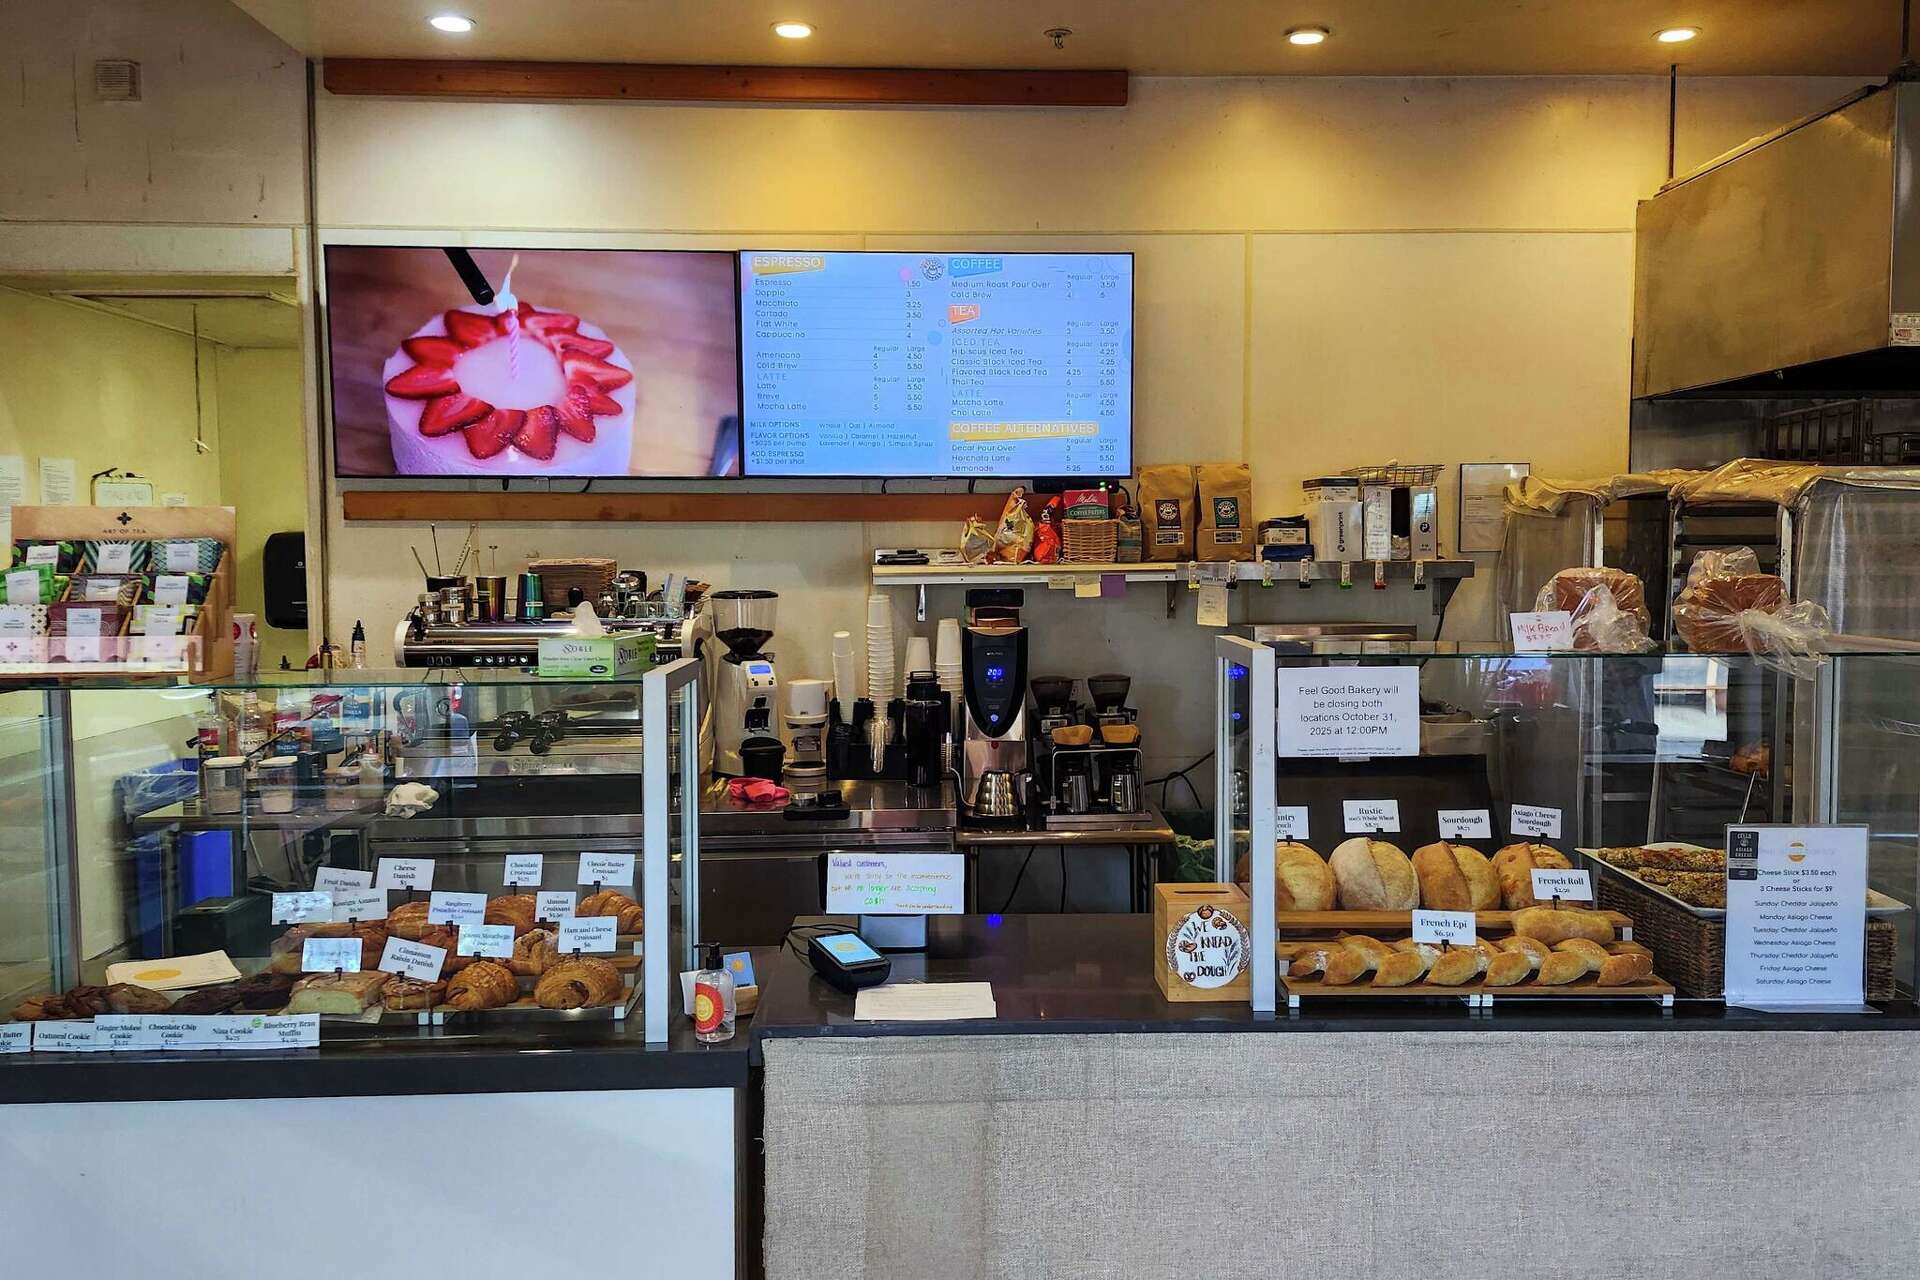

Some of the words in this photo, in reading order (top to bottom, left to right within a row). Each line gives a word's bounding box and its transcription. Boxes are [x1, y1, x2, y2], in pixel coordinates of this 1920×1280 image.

[754, 256, 821, 268] ESPRESSO
[952, 258, 1000, 269] COFFEE
[952, 306, 975, 315] TEA
[756, 331, 805, 339] Cappuccino
[952, 424, 1001, 433] COFFEE
[1006, 424, 1095, 433] ALTERNATIVES
[1517, 624, 1535, 633] Milk
[1299, 686, 1318, 695] Feel
[1321, 686, 1345, 694] Good
[1348, 686, 1380, 696] Bakery
[1314, 700, 1325, 708] be
[1328, 699, 1358, 709] closing
[1362, 699, 1382, 707] both
[1300, 713, 1339, 722] locations
[1342, 713, 1379, 721] October
[1382, 713, 1397, 722] 31,
[1310, 727, 1332, 735] 2025
[1346, 726, 1388, 735] 12:00PM
[1518, 818, 1551, 826] Sourdough
[1538, 877, 1566, 885] French
[1568, 877, 1584, 885] Roll
[1192, 921, 1209, 932] WE
[1420, 918, 1450, 927] French
[1453, 920, 1467, 928] Epi
[1201, 936, 1232, 948] KNEAD
[399, 946, 431, 958] Cinnamon
[391, 954, 410, 964] Raisin
[412, 958, 434, 968] Danish
[1197, 966, 1226, 976] DOUGH
